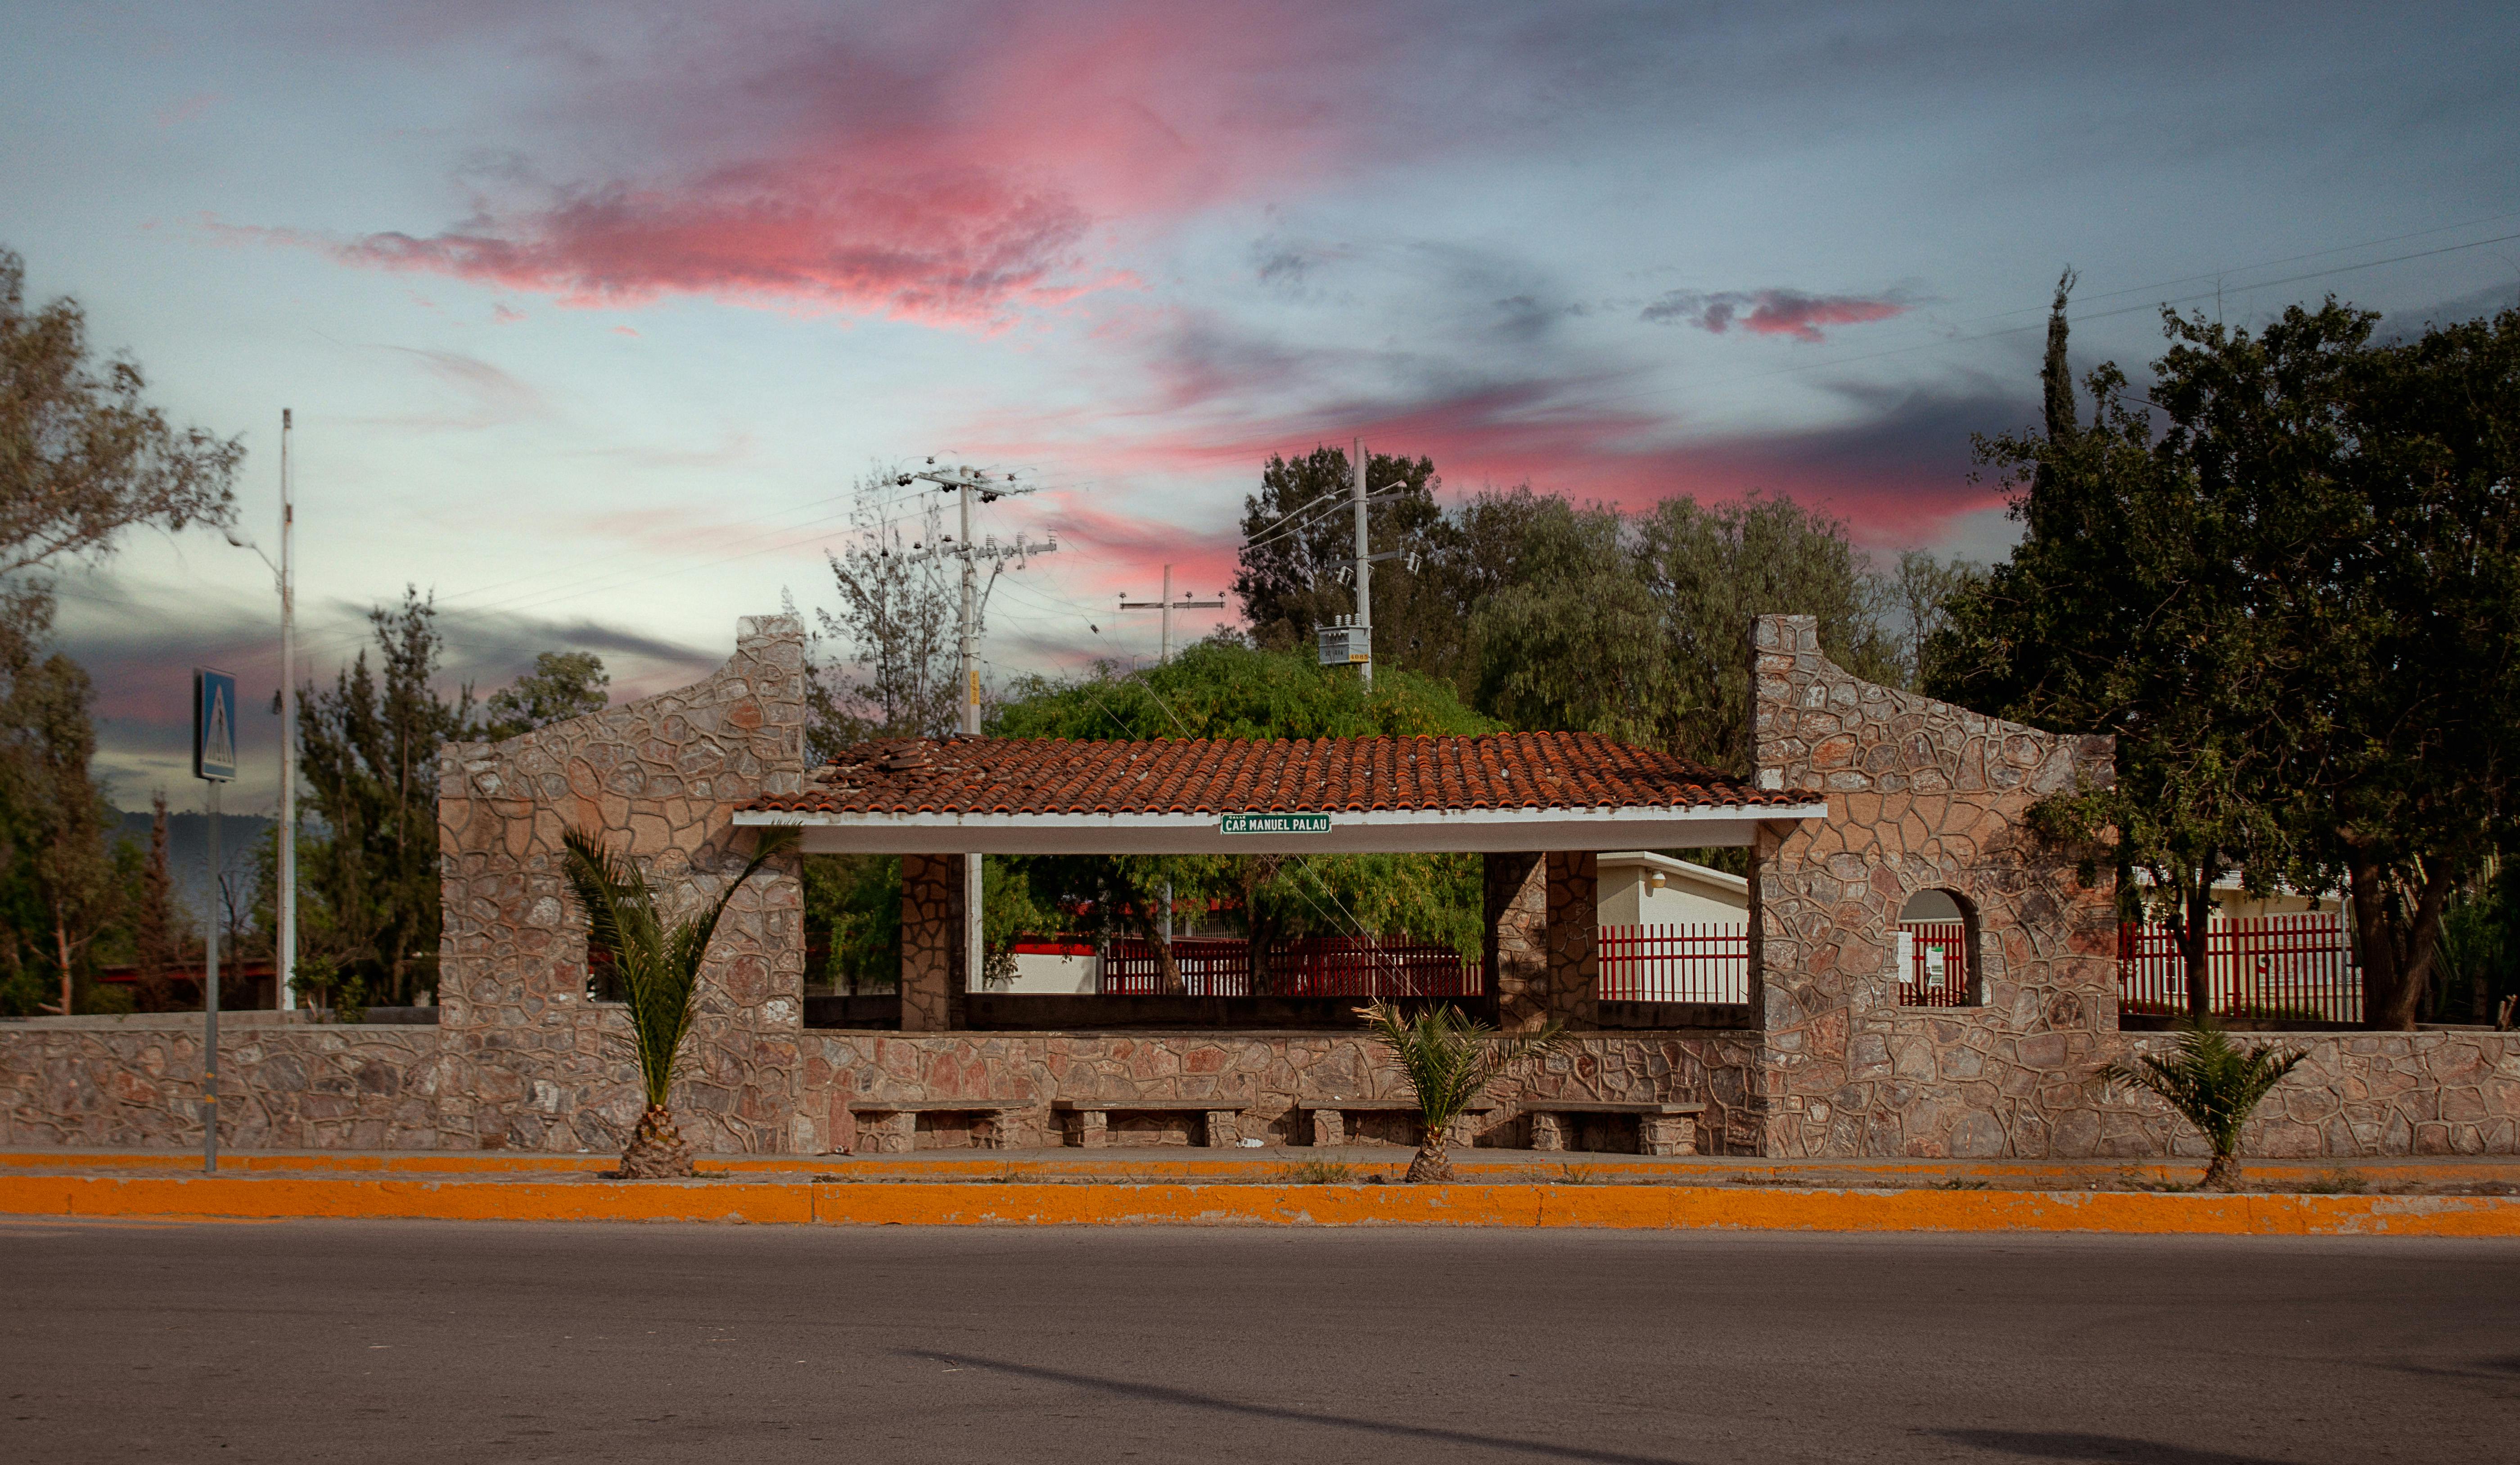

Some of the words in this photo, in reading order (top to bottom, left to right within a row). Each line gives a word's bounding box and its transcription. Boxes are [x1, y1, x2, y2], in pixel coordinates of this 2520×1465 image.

[1226, 820, 1246, 830] CAP.
[1249, 819, 1289, 830] MANUEL
[1293, 819, 1326, 830] PALAU
